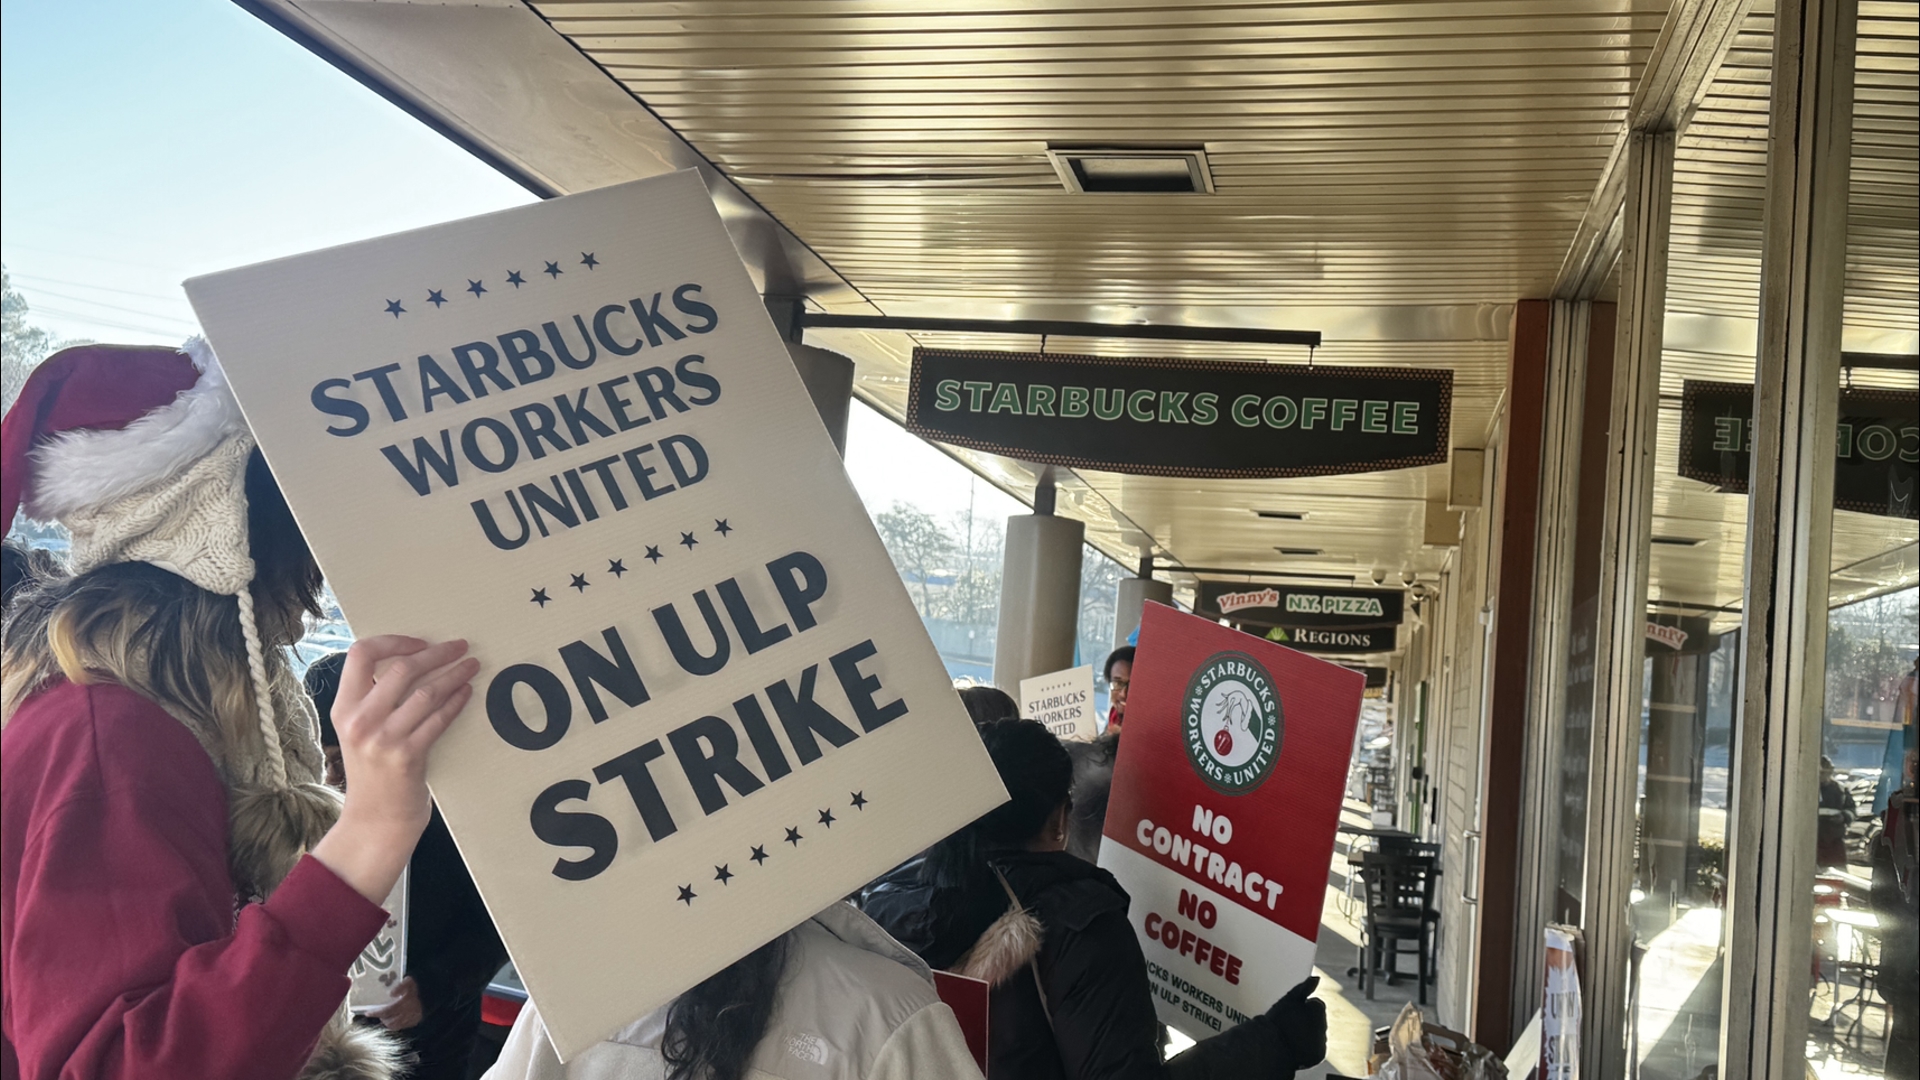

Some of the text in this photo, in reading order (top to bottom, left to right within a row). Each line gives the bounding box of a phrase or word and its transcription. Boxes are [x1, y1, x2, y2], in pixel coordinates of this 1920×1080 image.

[310, 283, 719, 438] STARBUCKS
[380, 354, 721, 497] WORKERS
[935, 379, 1420, 435] STARBUCKS COFFEE
[470, 434, 711, 550] UNITED
[1219, 590, 1380, 614] Vinny's N.Y. PIZZA
[485, 551, 828, 751] ON ULP
[1294, 628, 1371, 647] REGIONS
[1028, 690, 1086, 713] STARBUCKS
[1201, 661, 1275, 713] STARBUCKS
[1048, 722, 1076, 737] ITED
[1188, 698, 1223, 781] WORKERS
[529, 639, 909, 881] STRIKE
[1233, 728, 1275, 785] UNITED
[1192, 804, 1233, 845] NO
[1136, 819, 1284, 911] CONTRACT
[1178, 888, 1217, 929] NO
[1145, 912, 1243, 986] COFFEE
[1160, 987, 1180, 1006] ULP
[1171, 973, 1251, 1025] WORKERS UNI
[784, 1034, 813, 1052] NORTH
[789, 1046, 811, 1061] FACE
[801, 1033, 817, 1045] THE
